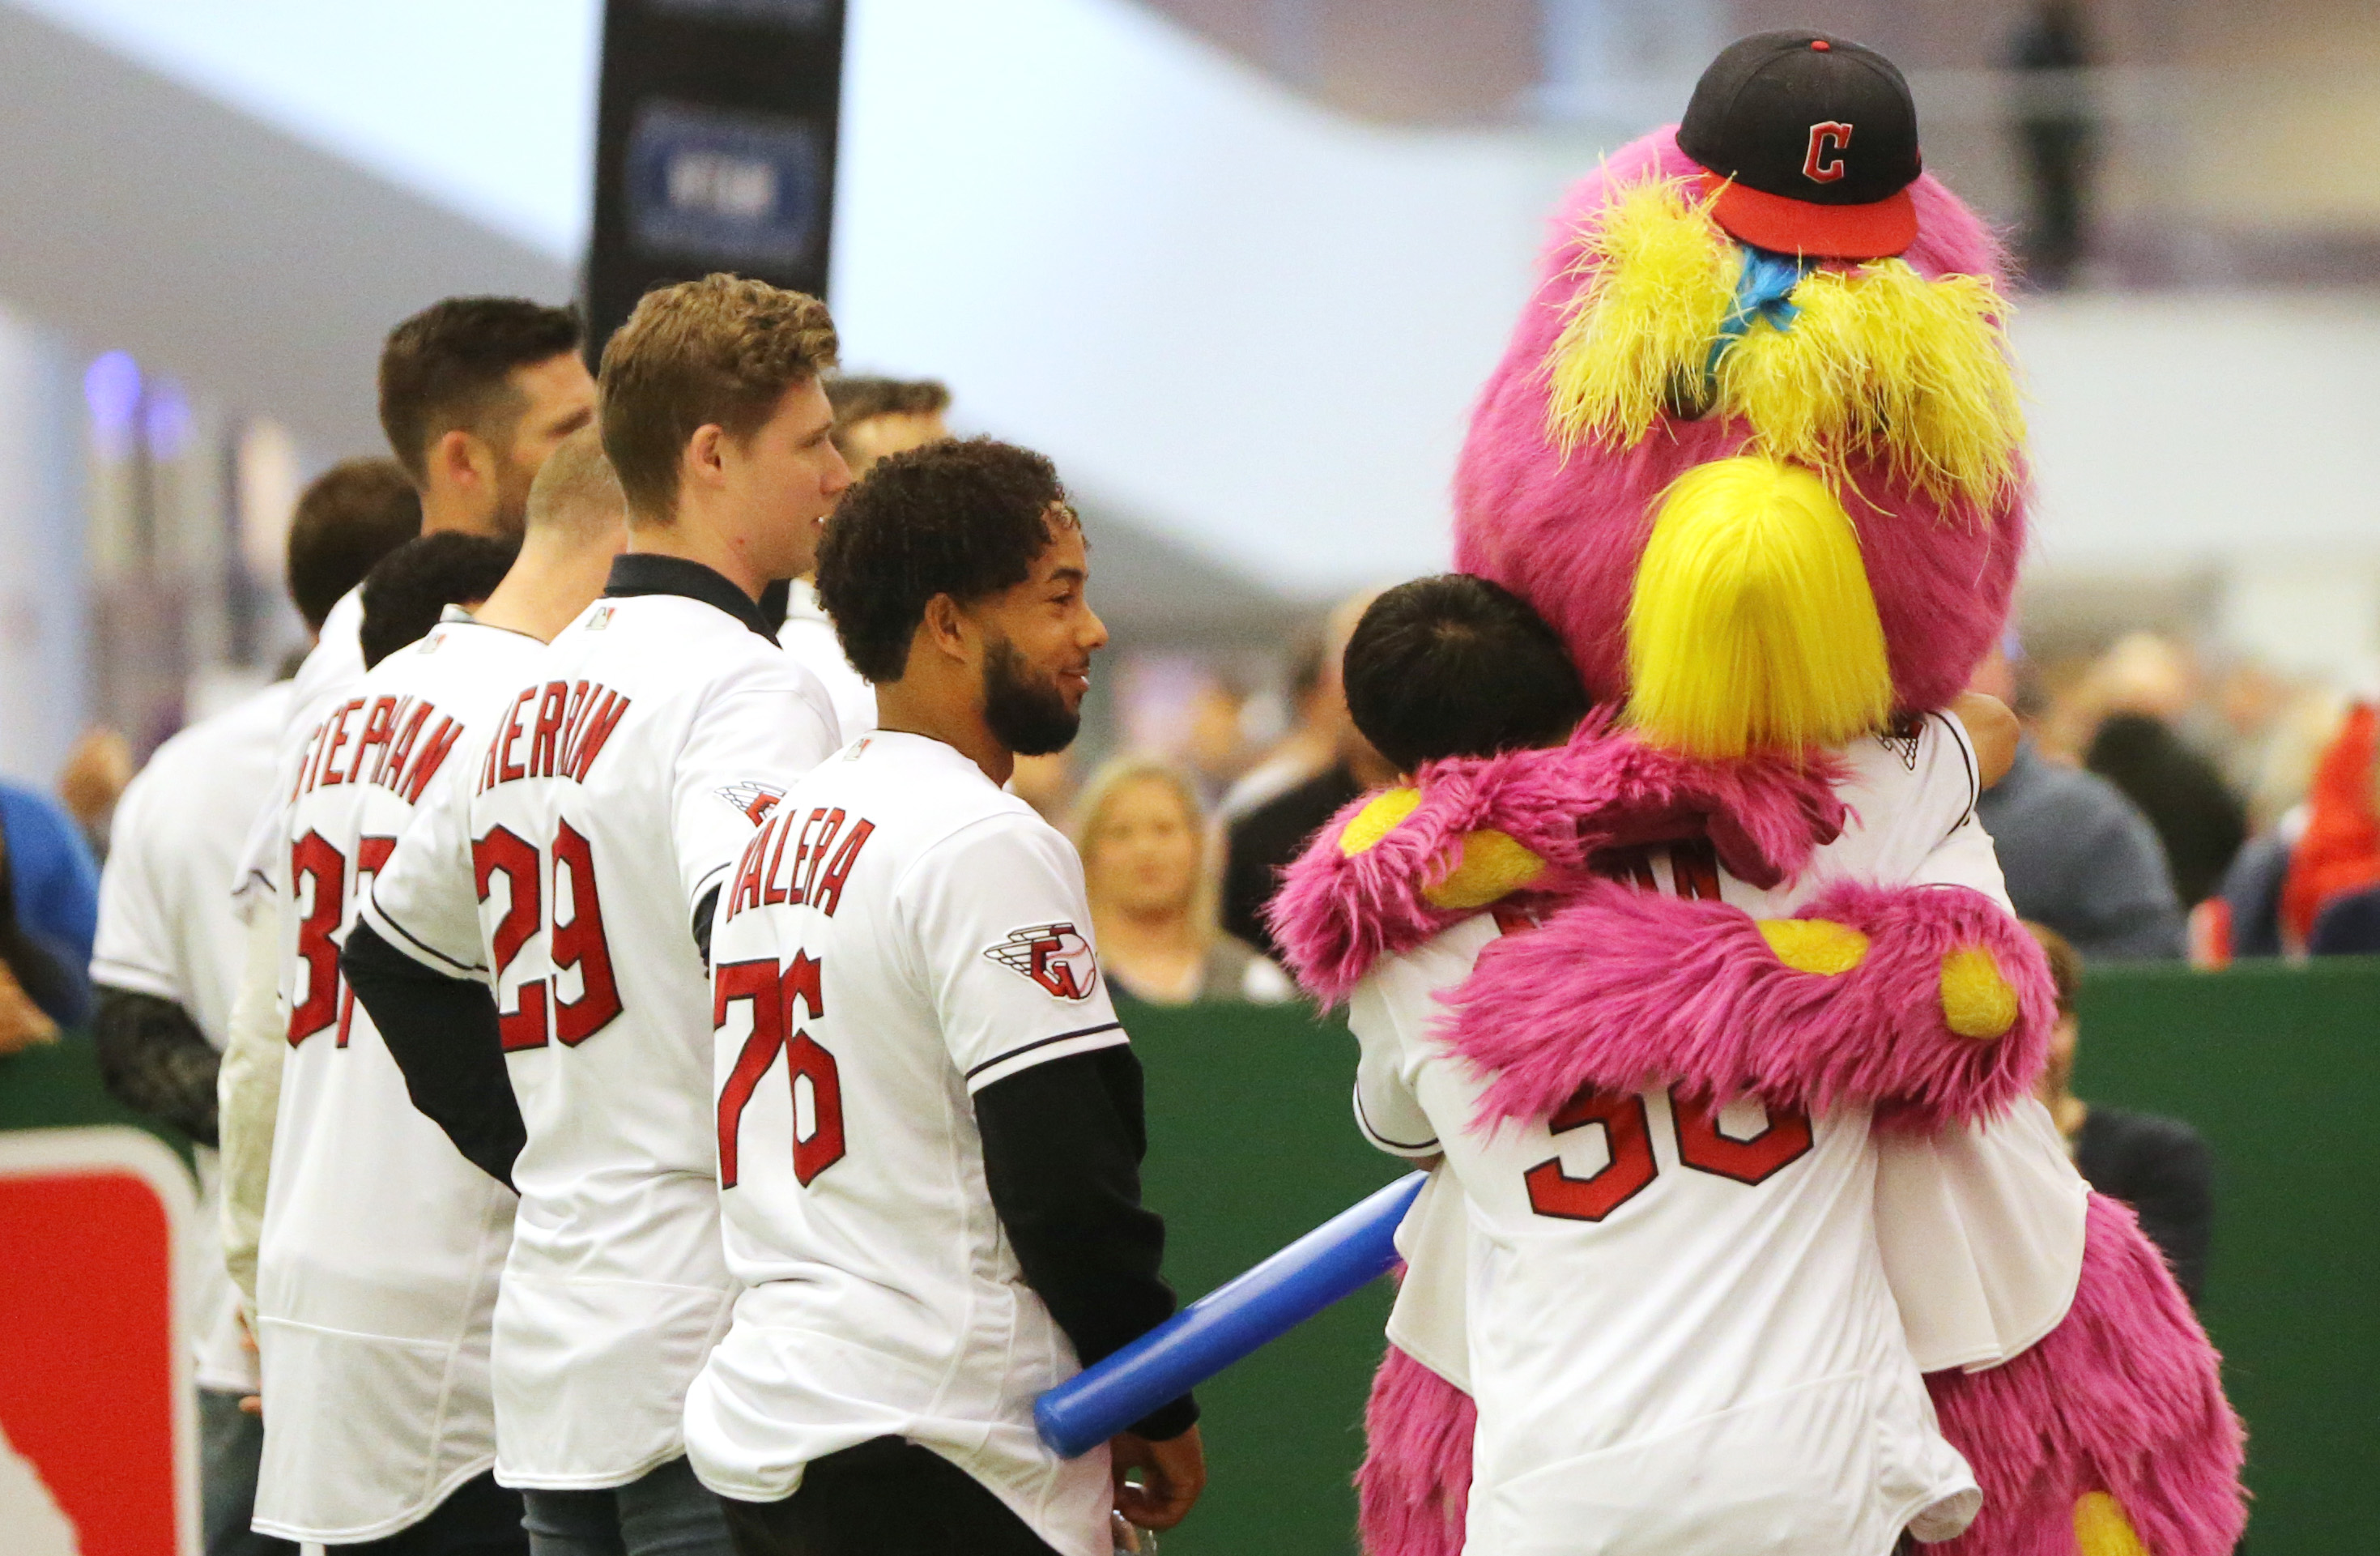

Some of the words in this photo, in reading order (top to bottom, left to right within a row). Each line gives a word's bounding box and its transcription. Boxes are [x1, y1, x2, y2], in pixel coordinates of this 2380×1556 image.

[1802, 121, 1854, 184] C
[471, 815, 624, 1053] 29
[713, 948, 846, 1191] 76
